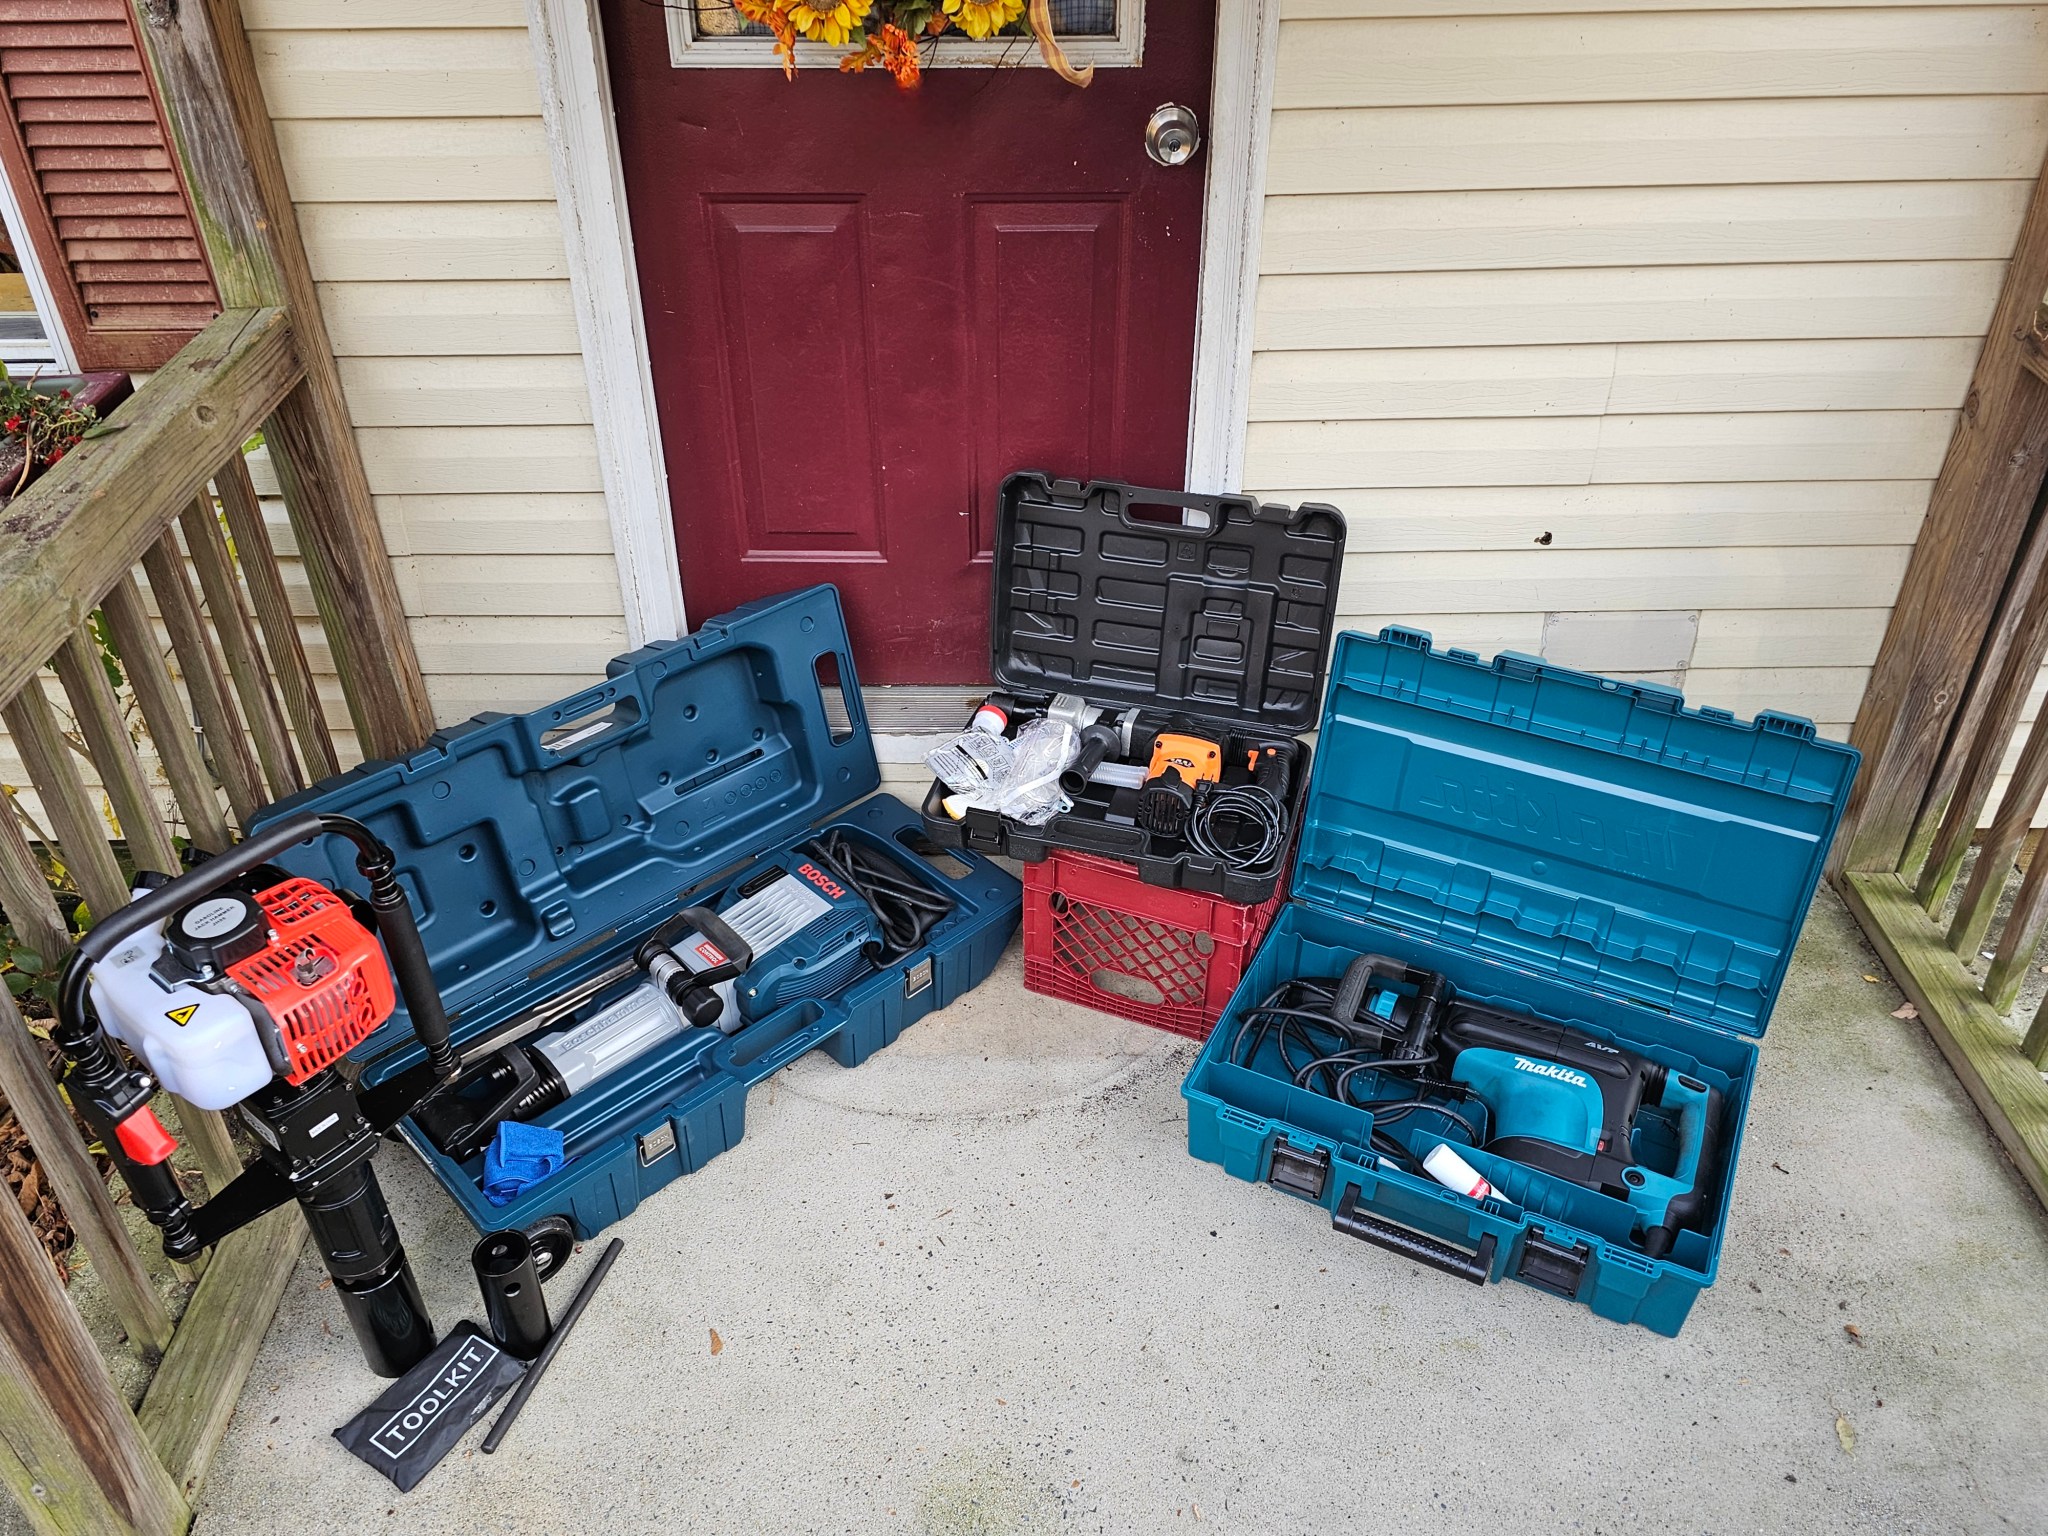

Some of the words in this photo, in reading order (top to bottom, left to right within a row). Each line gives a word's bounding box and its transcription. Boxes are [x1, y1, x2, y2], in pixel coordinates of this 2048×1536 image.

[797, 863, 847, 900] BOSCH
[194, 906, 224, 925] GASOLINE
[194, 920, 210, 931] JACK
[210, 905, 236, 923] HAMMER
[1584, 1041, 1620, 1054] AVT
[1514, 1056, 1588, 1088] makita
[385, 1346, 483, 1443] TOOLKIT
